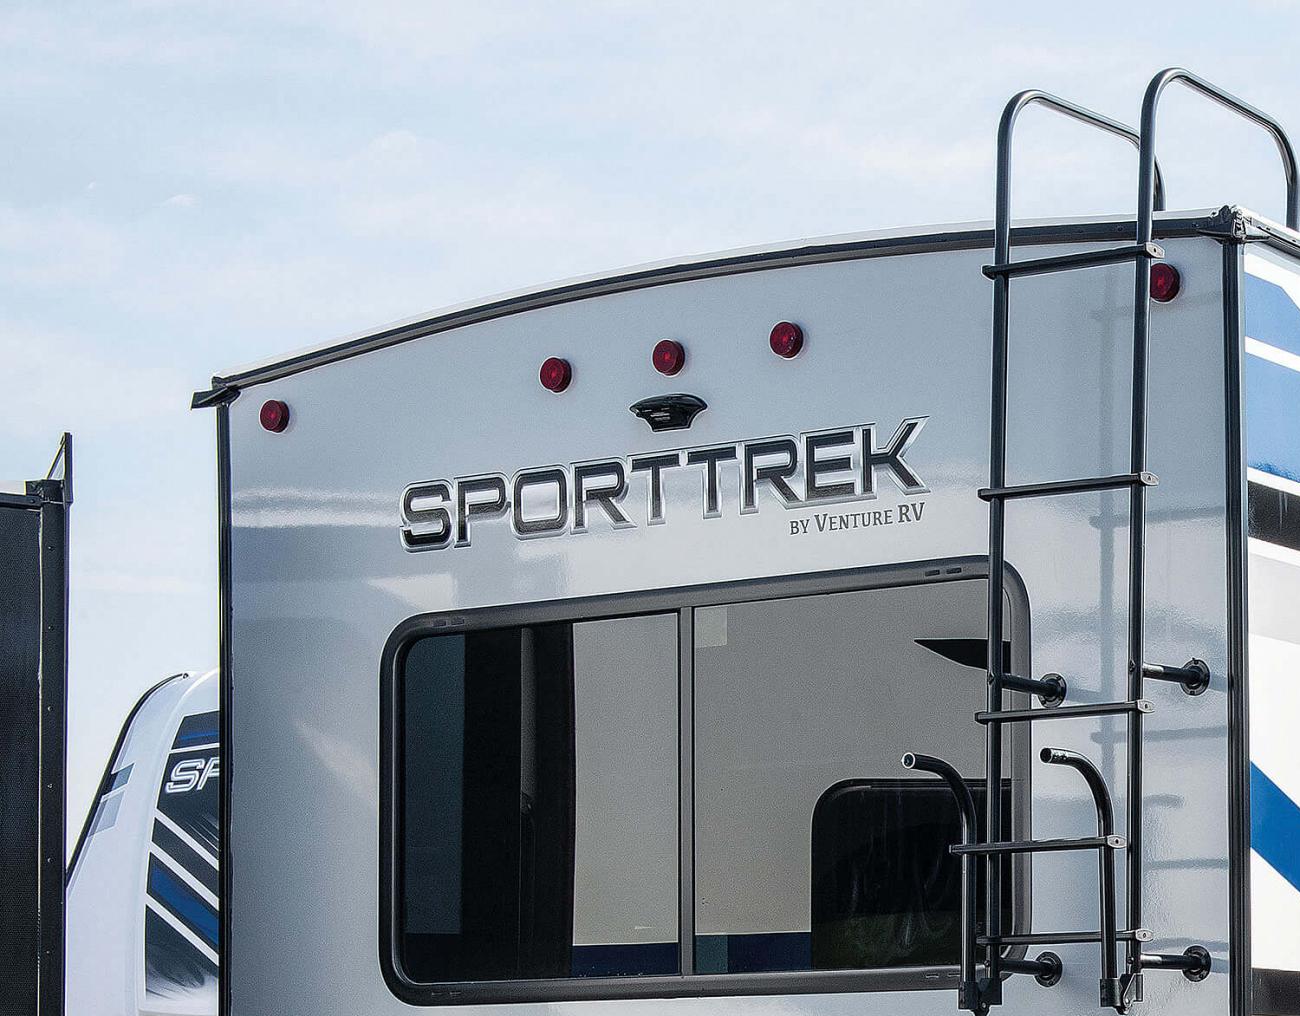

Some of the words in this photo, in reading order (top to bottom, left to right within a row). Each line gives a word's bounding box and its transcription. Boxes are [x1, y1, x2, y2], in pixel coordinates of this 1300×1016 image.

[400, 415, 930, 553] SPORTTREK
[790, 518, 811, 536] BY
[814, 513, 893, 533] VENTURE
[897, 501, 925, 524] RV
